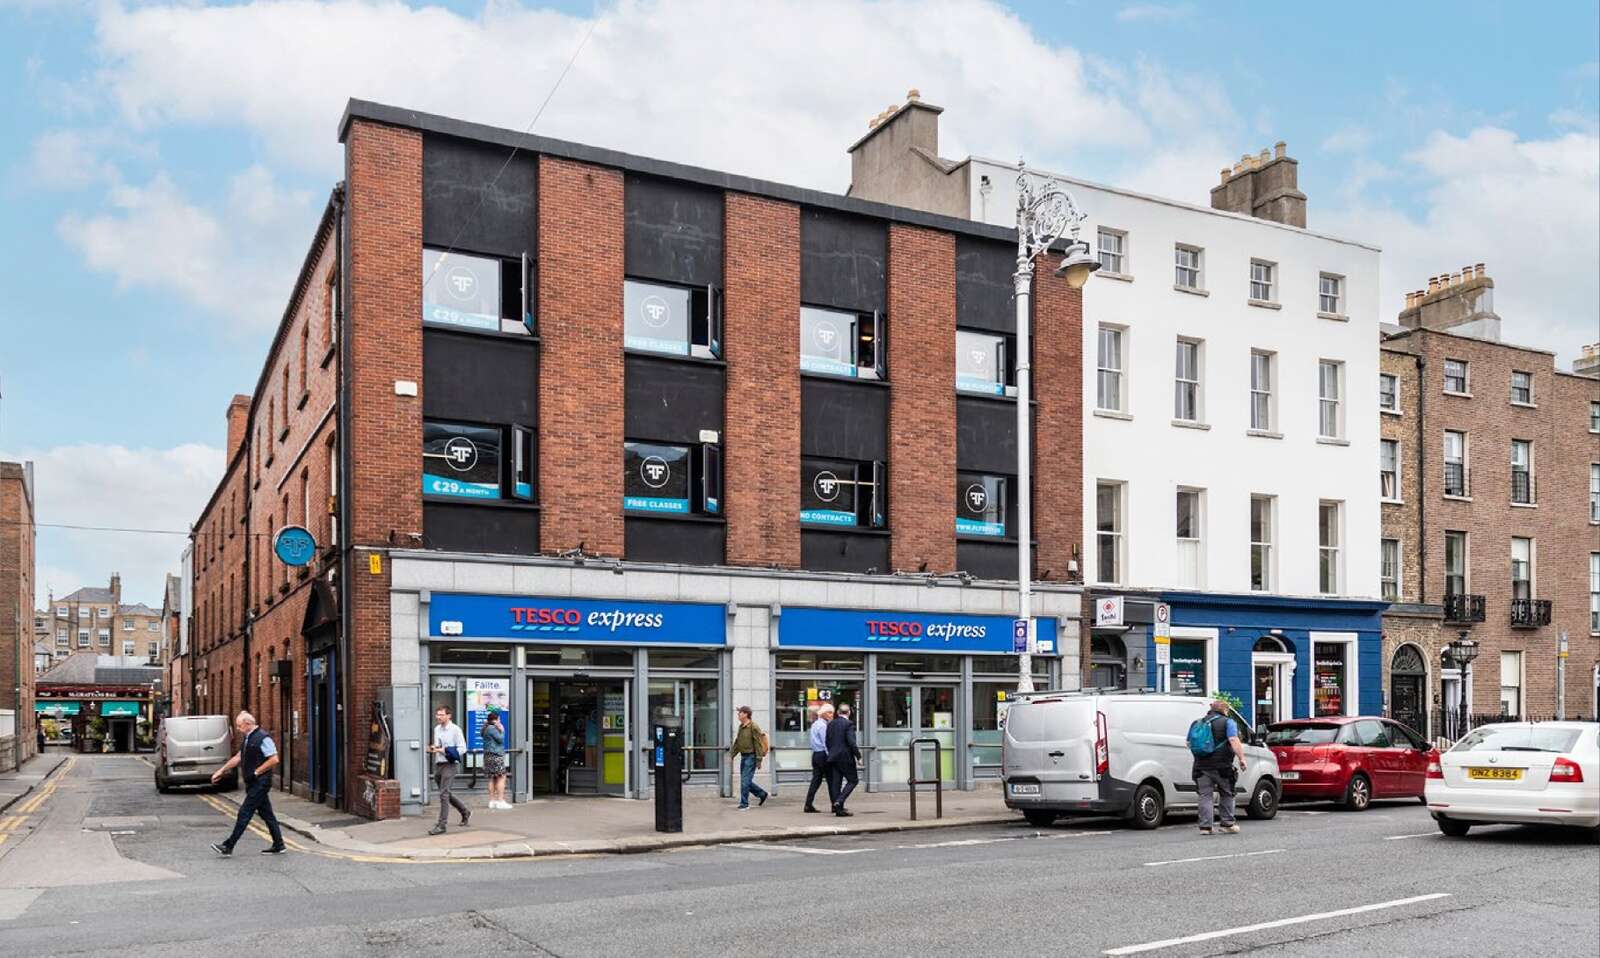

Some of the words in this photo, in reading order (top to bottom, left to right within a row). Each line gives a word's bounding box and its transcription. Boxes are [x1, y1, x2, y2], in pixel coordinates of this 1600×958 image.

[433, 480, 459, 493] €29
[466, 488, 490, 496] MONTH
[627, 499, 647, 507] FREE
[649, 501, 682, 510] CLASSES
[811, 513, 852, 522] CONTRACTS
[510, 607, 581, 625] TESCO
[588, 610, 663, 631] express
[866, 621, 922, 636] TESCO
[926, 622, 986, 641] express
